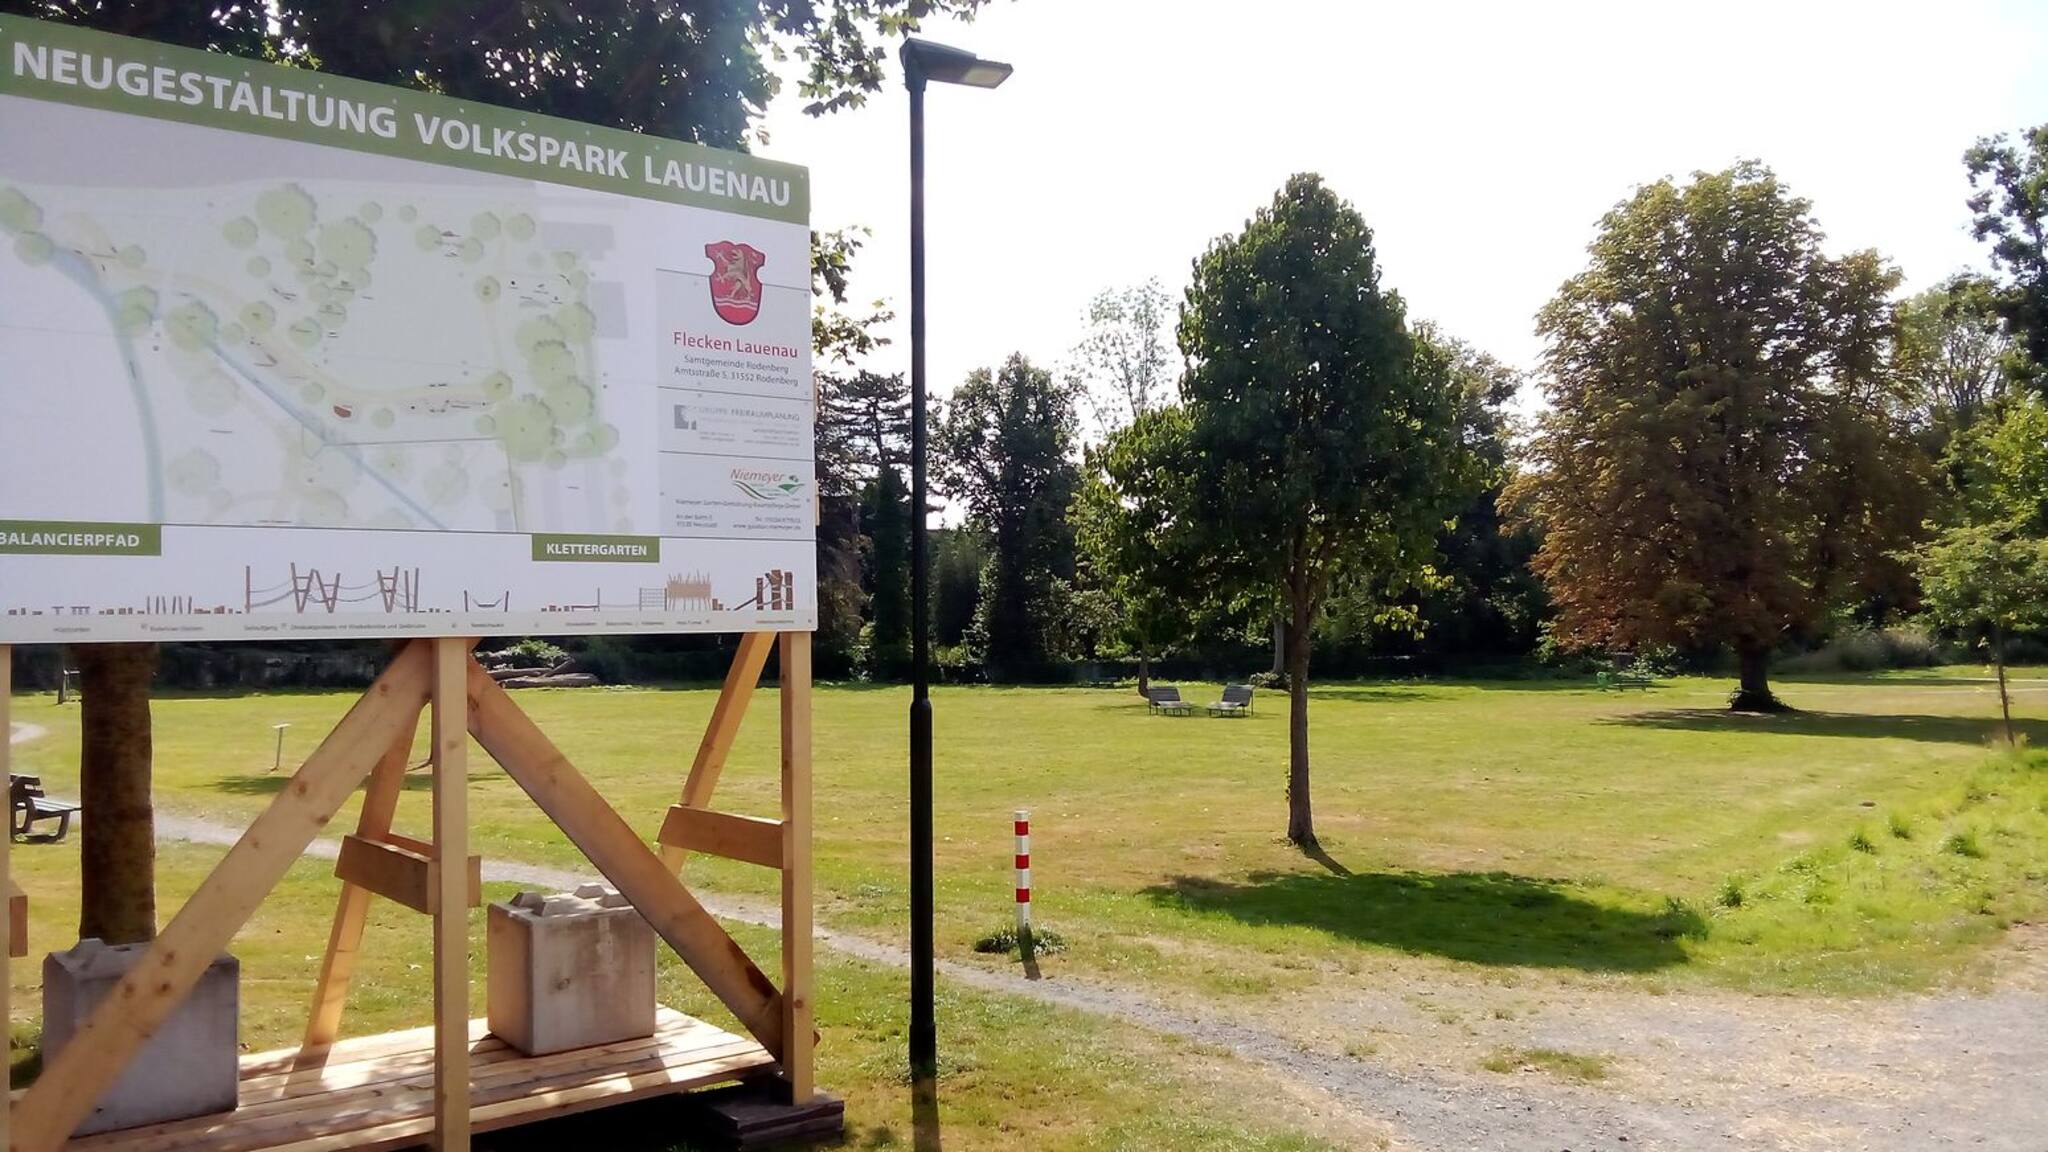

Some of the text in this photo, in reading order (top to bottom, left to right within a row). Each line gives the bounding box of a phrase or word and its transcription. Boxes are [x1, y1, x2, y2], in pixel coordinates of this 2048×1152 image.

[14, 42, 790, 207] NEUGESTALTUNG VOLKSPARK LAUENAU
[673, 331, 798, 358] Flecken Lauenau
[684, 355, 789, 375] Samtgemeinde Rodenberg
[674, 366, 720, 378] Amtsstraße
[756, 374, 799, 387] Rodenberg
[730, 469, 785, 484] Niemeyer
[0, 532, 140, 548] BALANCIERPFAD
[546, 543, 647, 557] KLETTERGARTEN
